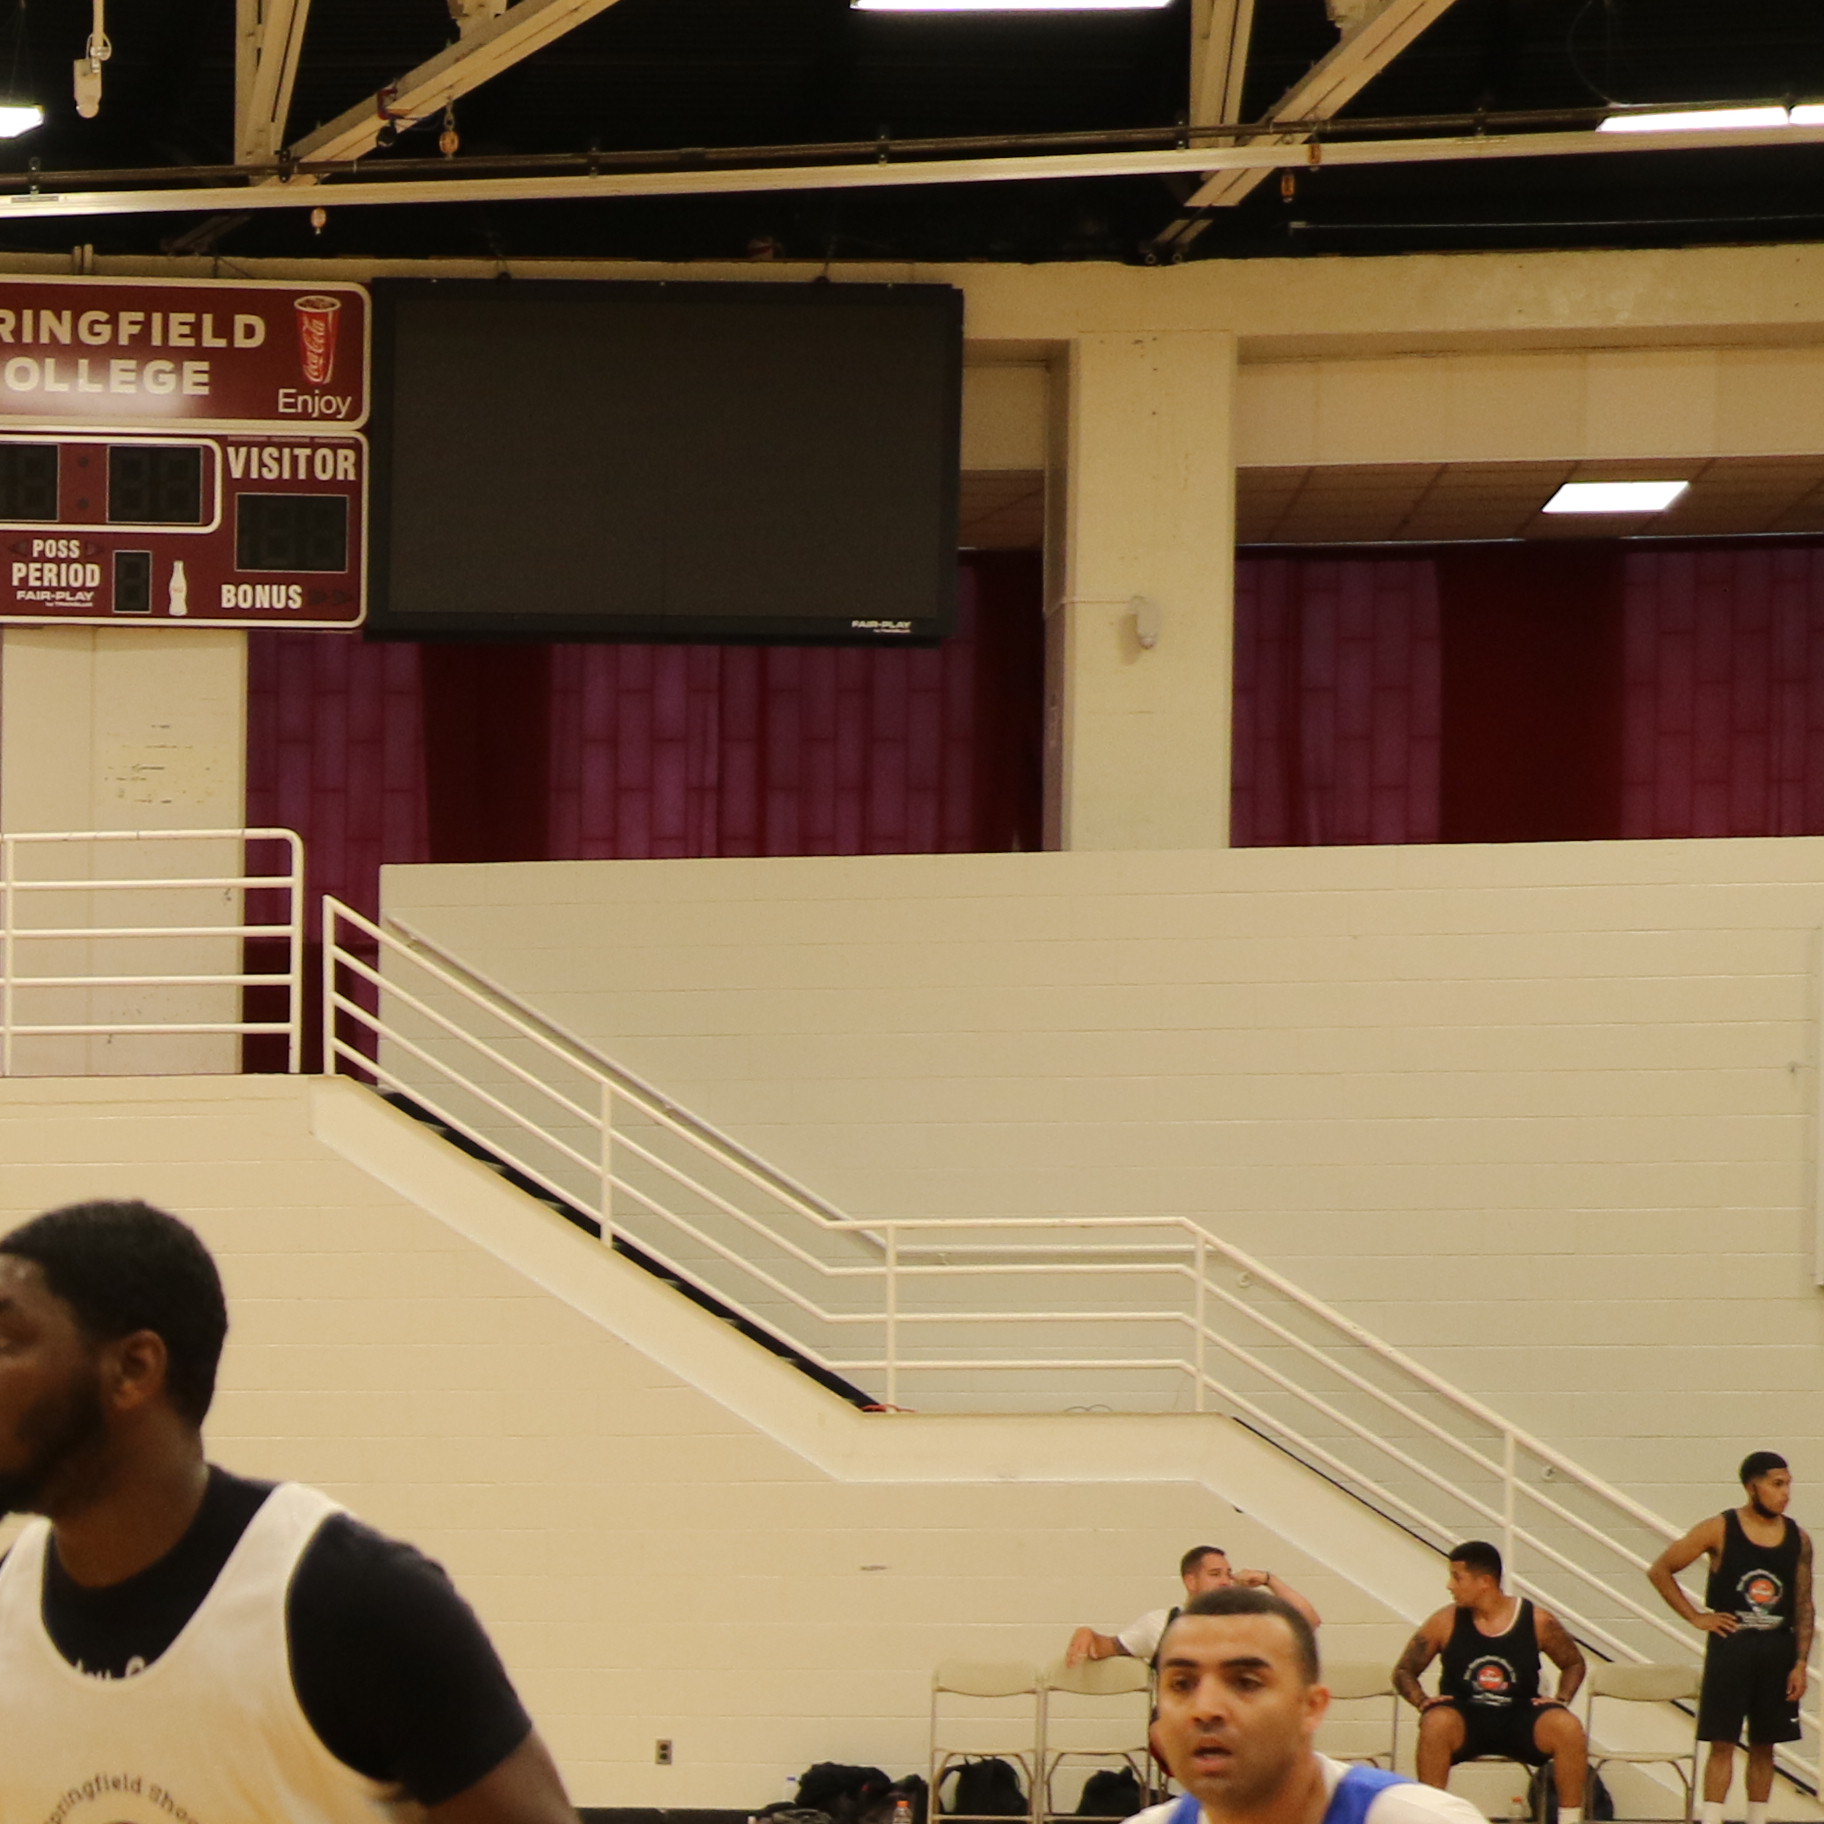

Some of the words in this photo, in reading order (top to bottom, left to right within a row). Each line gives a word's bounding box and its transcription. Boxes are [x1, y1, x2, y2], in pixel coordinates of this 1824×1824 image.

[277, 388, 352, 418] Enjoy
[227, 446, 356, 481] VISITOR
[32, 539, 80, 558] POSS
[11, 562, 101, 588] PERIOD
[16, 590, 94, 601] FAIR-PLAY
[221, 584, 302, 609] BONUS
